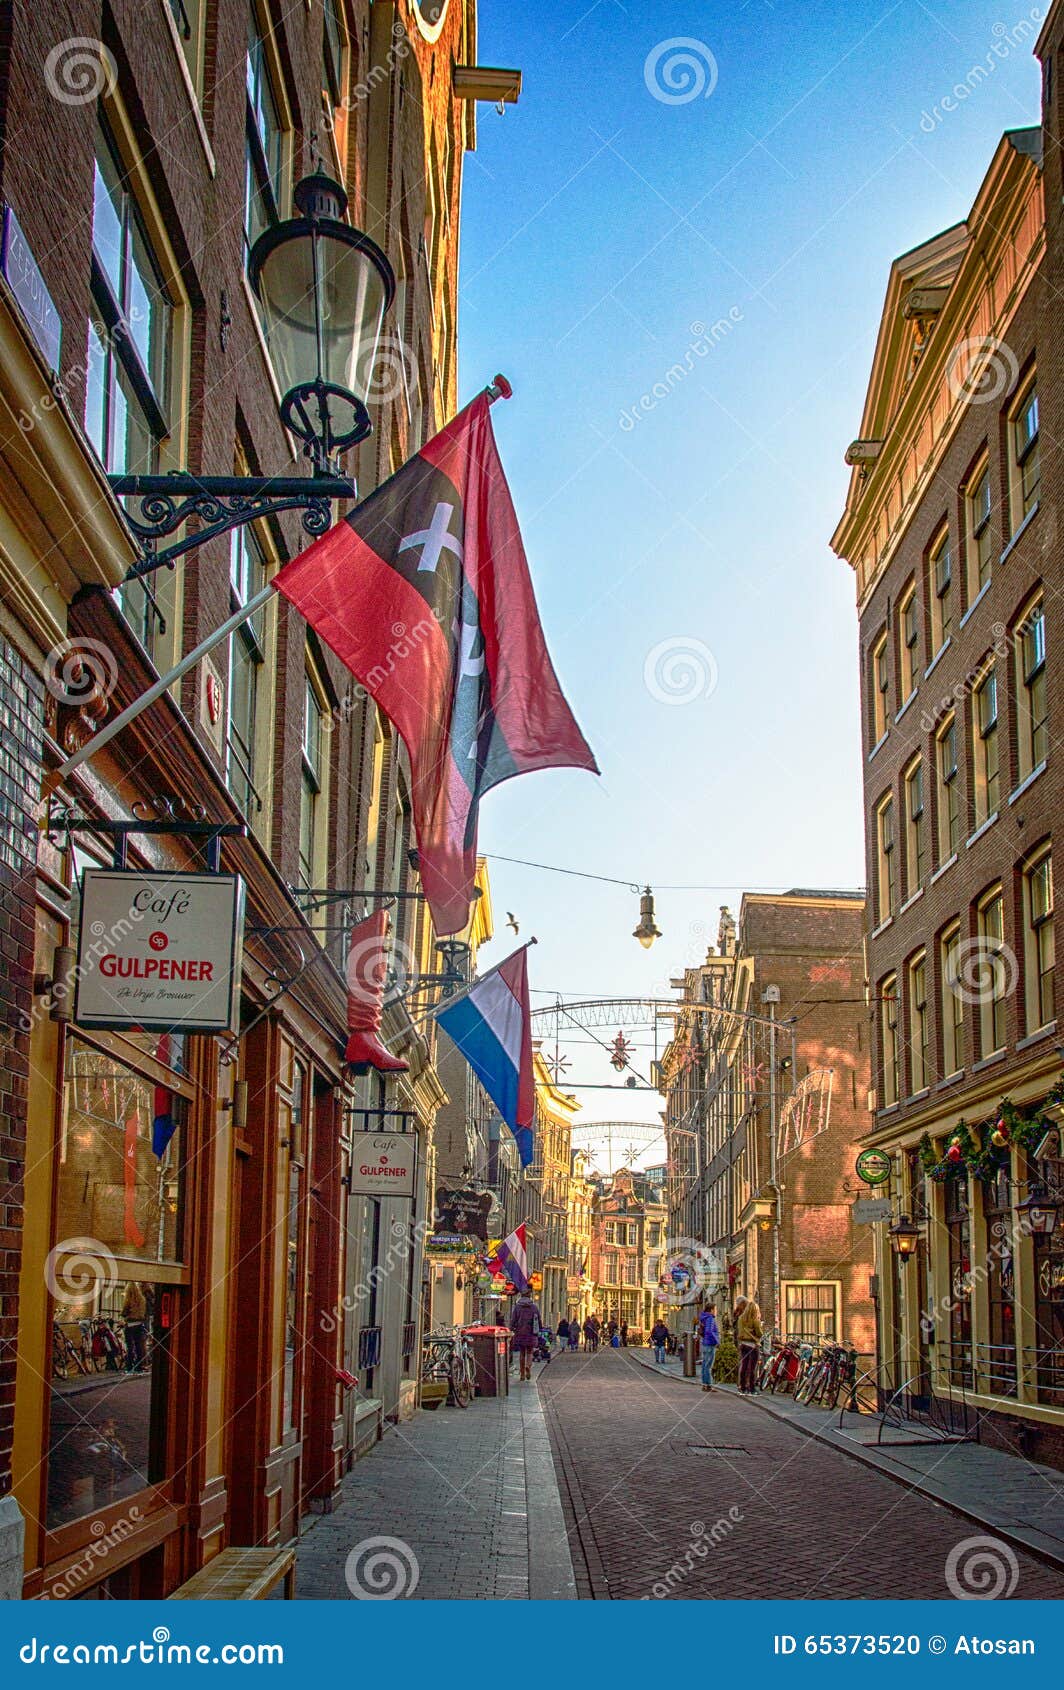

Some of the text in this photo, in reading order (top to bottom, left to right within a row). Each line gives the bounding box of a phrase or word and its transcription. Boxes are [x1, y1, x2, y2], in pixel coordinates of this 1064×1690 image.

[133, 888, 192, 924] Café
[99, 953, 214, 982] GULPENER
[359, 1165, 407, 1177] GULPENER
